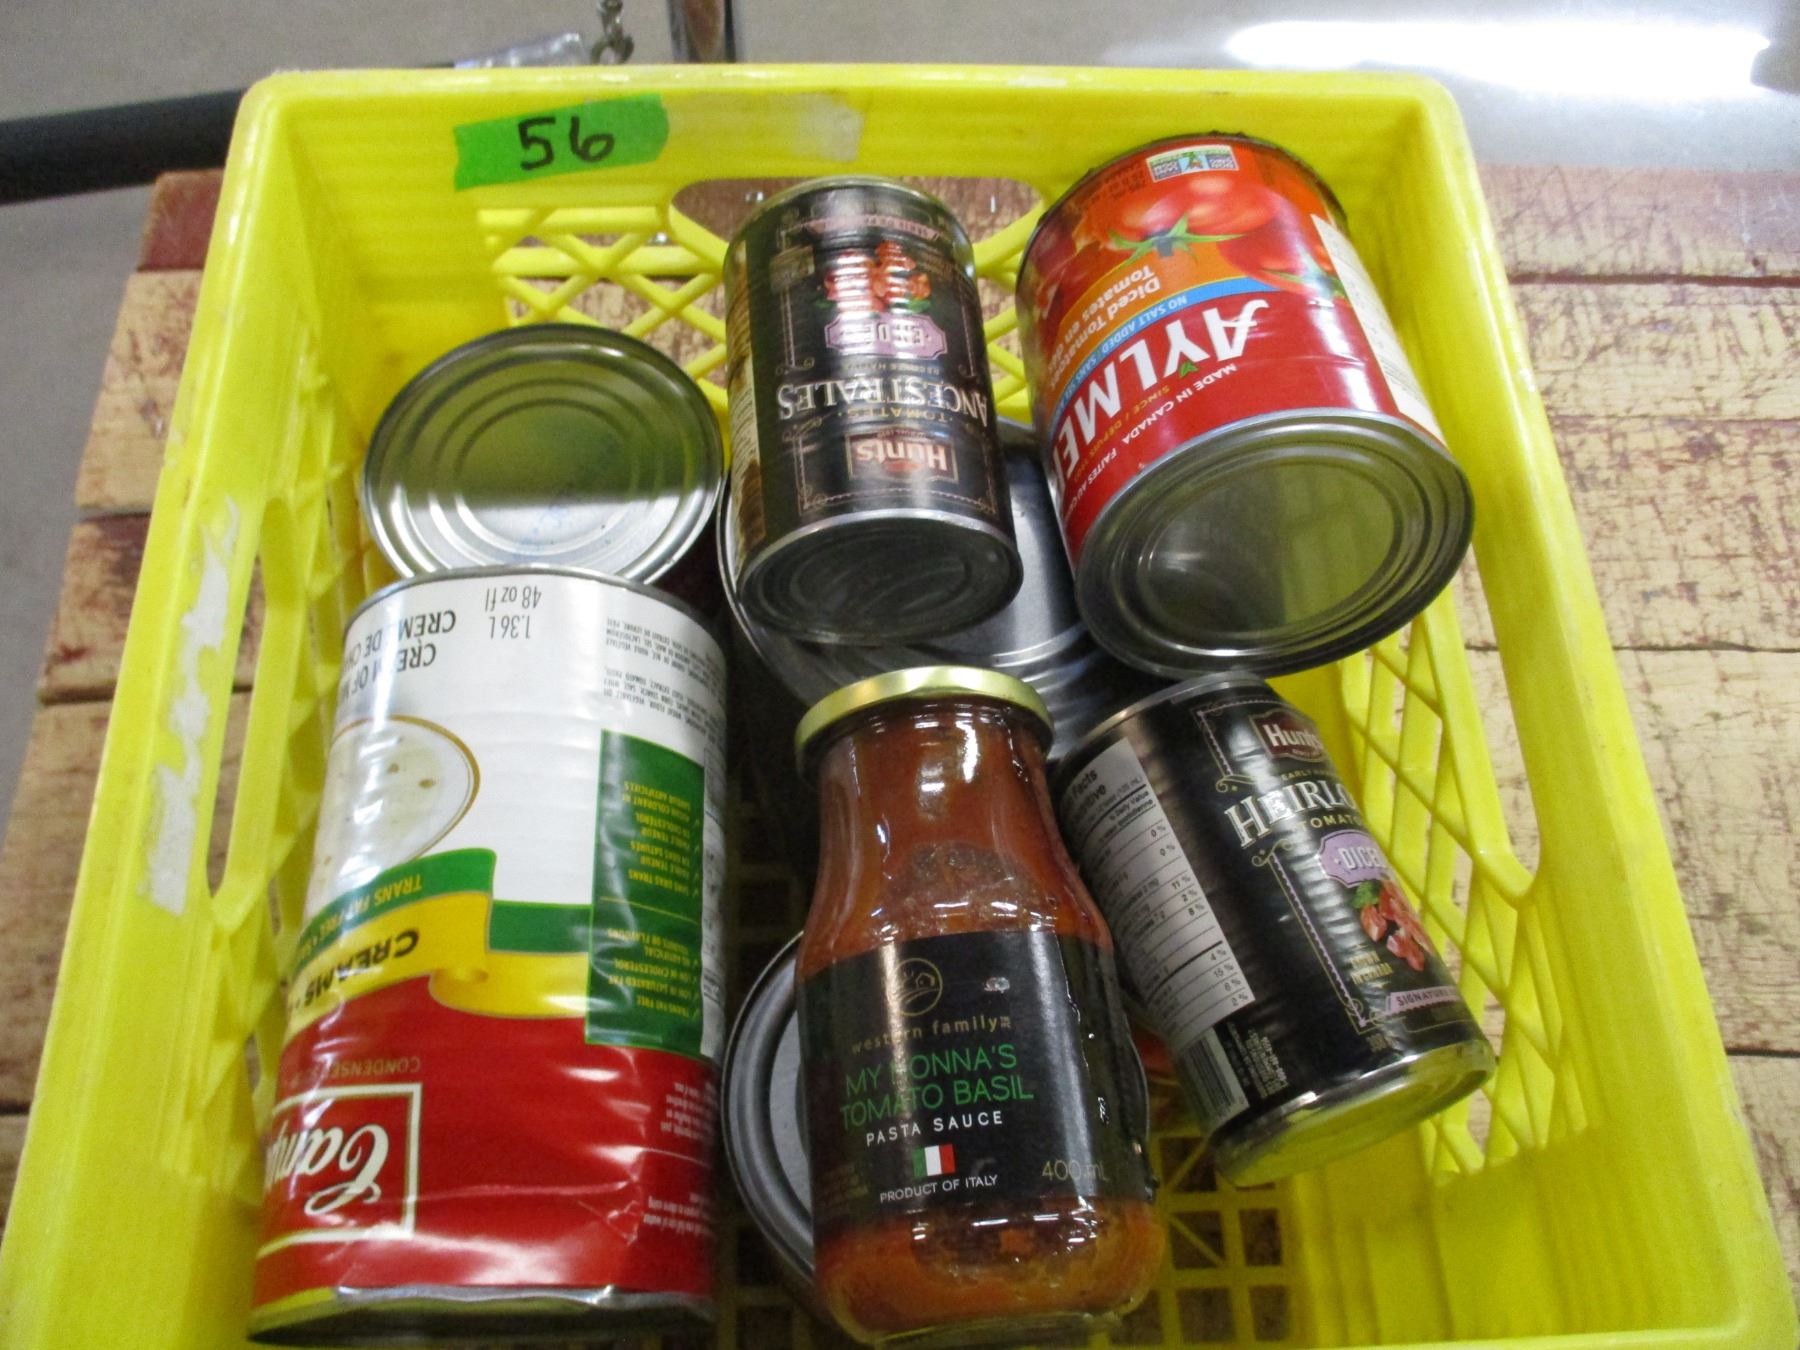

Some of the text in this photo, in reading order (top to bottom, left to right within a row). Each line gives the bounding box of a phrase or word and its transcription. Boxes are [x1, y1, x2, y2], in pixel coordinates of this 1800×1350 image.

[517, 115, 616, 171] 56
[1082, 265, 1156, 321] Tomates
[1107, 276, 1162, 320] Diced
[1167, 294, 1188, 310] NO
[1138, 304, 1167, 325] SALT
[1101, 321, 1136, 354] ADDED
[1193, 362, 1238, 391] MADE
[777, 377, 988, 427] ANCESTRALES
[1175, 384, 1194, 404] IN
[1121, 400, 1174, 445] CANADA
[1088, 447, 1118, 484] FAITES
[500, 586, 518, 604] oz
[522, 585, 542, 610] 48
[366, 630, 383, 656] DE
[386, 609, 456, 645] CRÈM
[488, 614, 532, 640] 1.36 L
[373, 873, 422, 906] TRANS
[851, 1025, 922, 1055] westrn
[932, 1013, 997, 1034] family
[845, 1063, 882, 1097] MY
[839, 1075, 1035, 1132] TOMATO BASIL
[865, 1110, 1003, 1147] PASTA SAUCE
[879, 1173, 1000, 1204] PRODUCT OF ITALY
